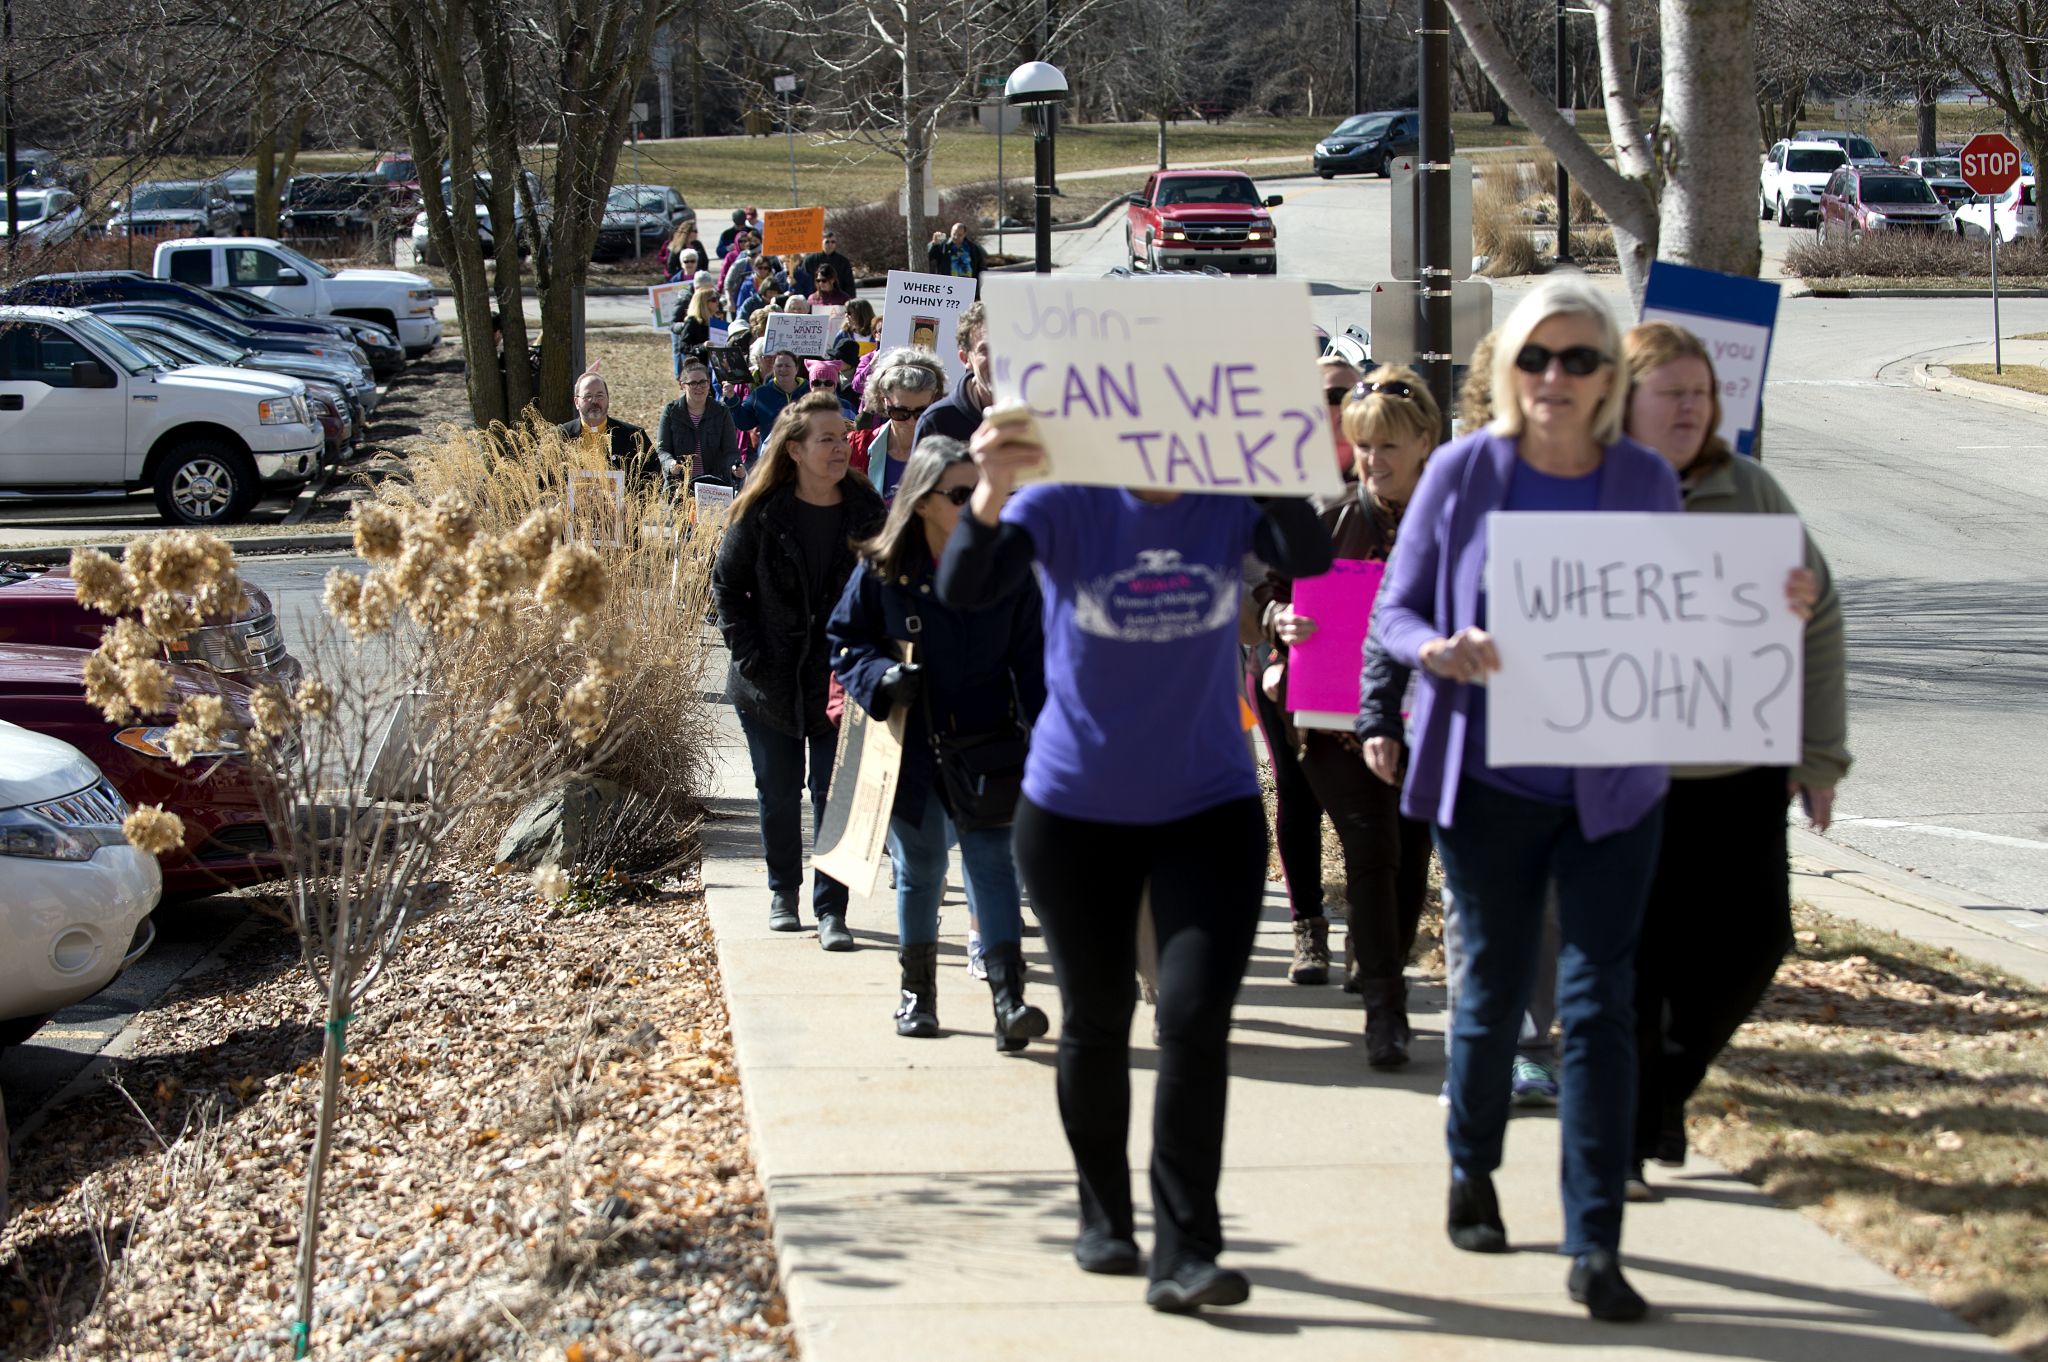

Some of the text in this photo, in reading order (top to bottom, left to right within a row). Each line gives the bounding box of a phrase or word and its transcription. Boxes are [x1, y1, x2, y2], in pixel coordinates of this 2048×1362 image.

[1964, 152, 2017, 177] STOP
[898, 295, 960, 309] JOHHNY ???
[777, 316, 821, 327] The Pigeon
[793, 326, 823, 334] WANTS
[1714, 338, 1755, 361] you
[1165, 362, 1263, 419] WE
[1513, 551, 1769, 628] WHERE'S
